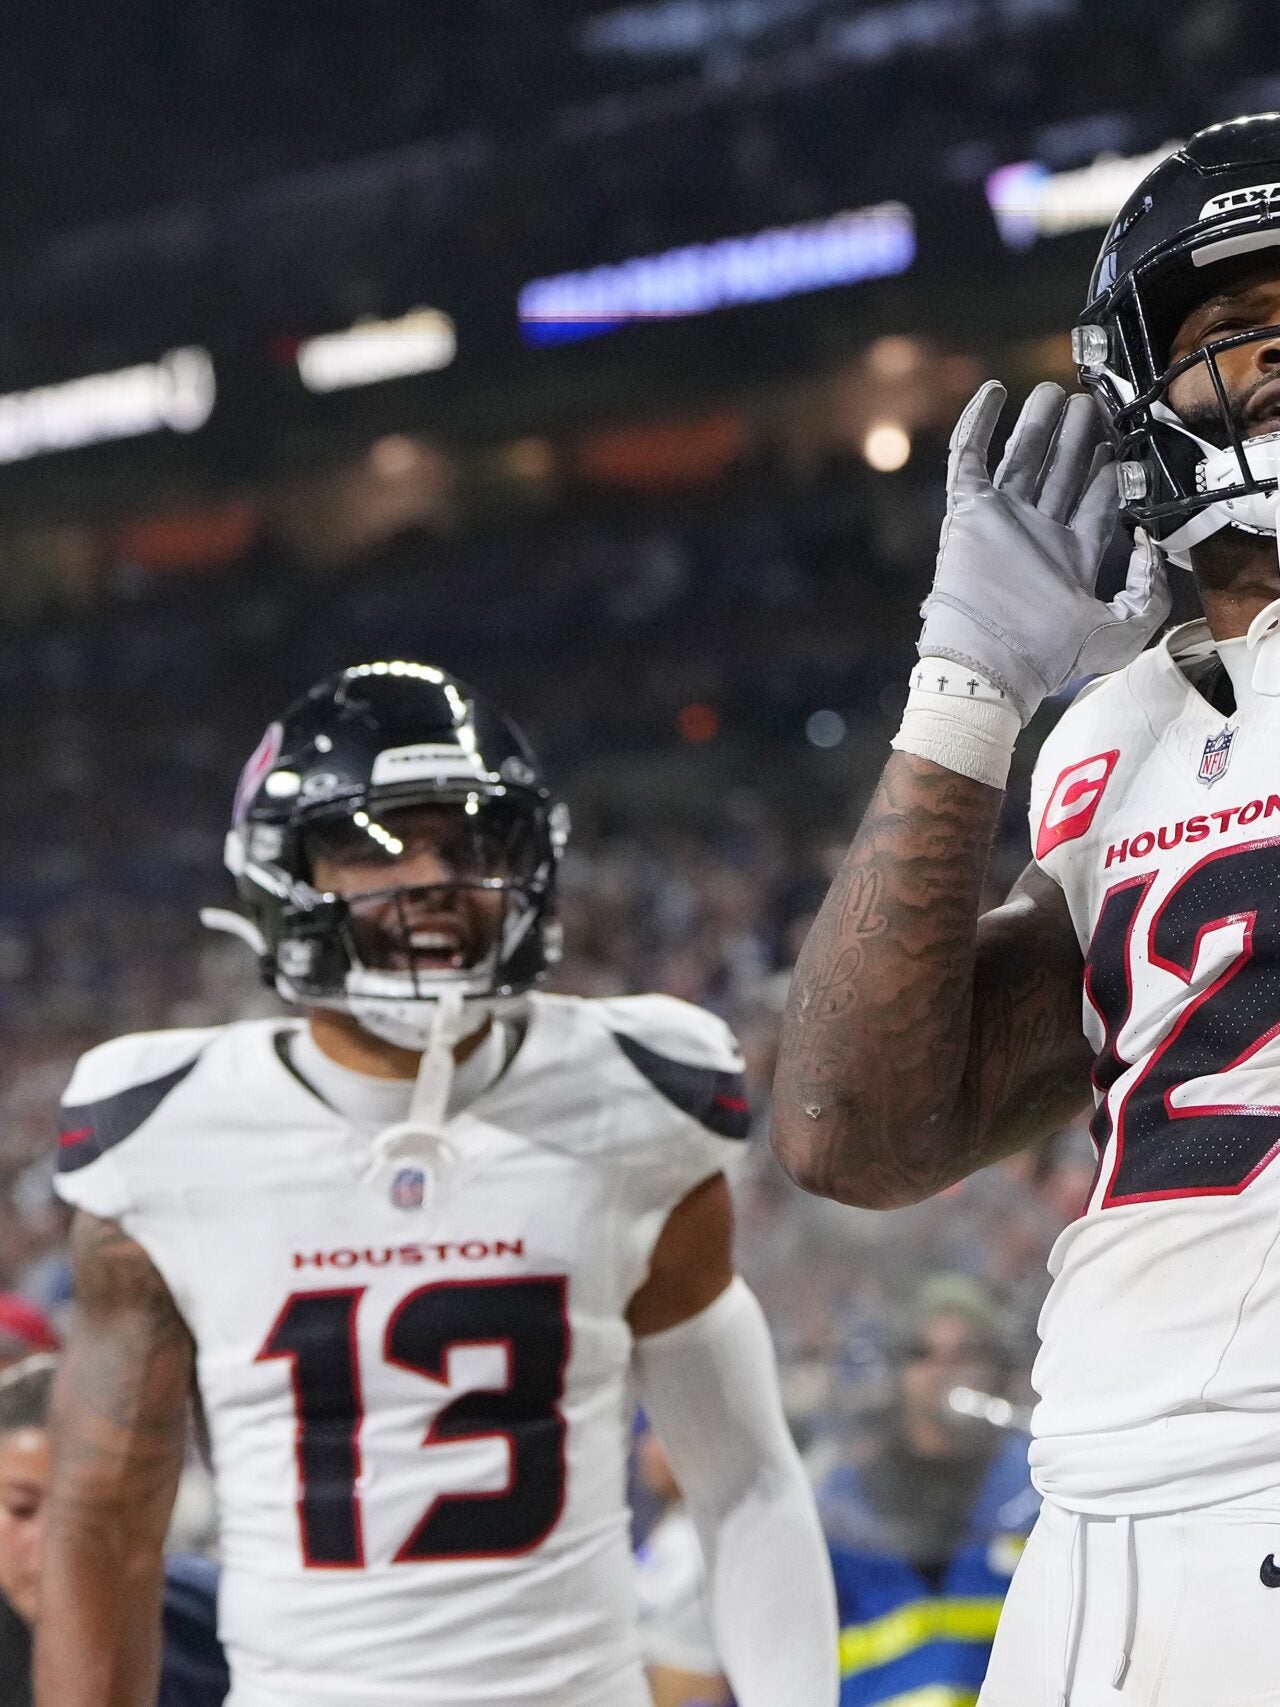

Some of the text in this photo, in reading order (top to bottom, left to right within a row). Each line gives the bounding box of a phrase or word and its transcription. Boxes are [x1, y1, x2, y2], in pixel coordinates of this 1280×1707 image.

[1201, 751, 1224, 775] NFL
[1045, 757, 1108, 829] C
[292, 1238, 525, 1270] HOUSTON
[252, 1273, 574, 1571] 13
